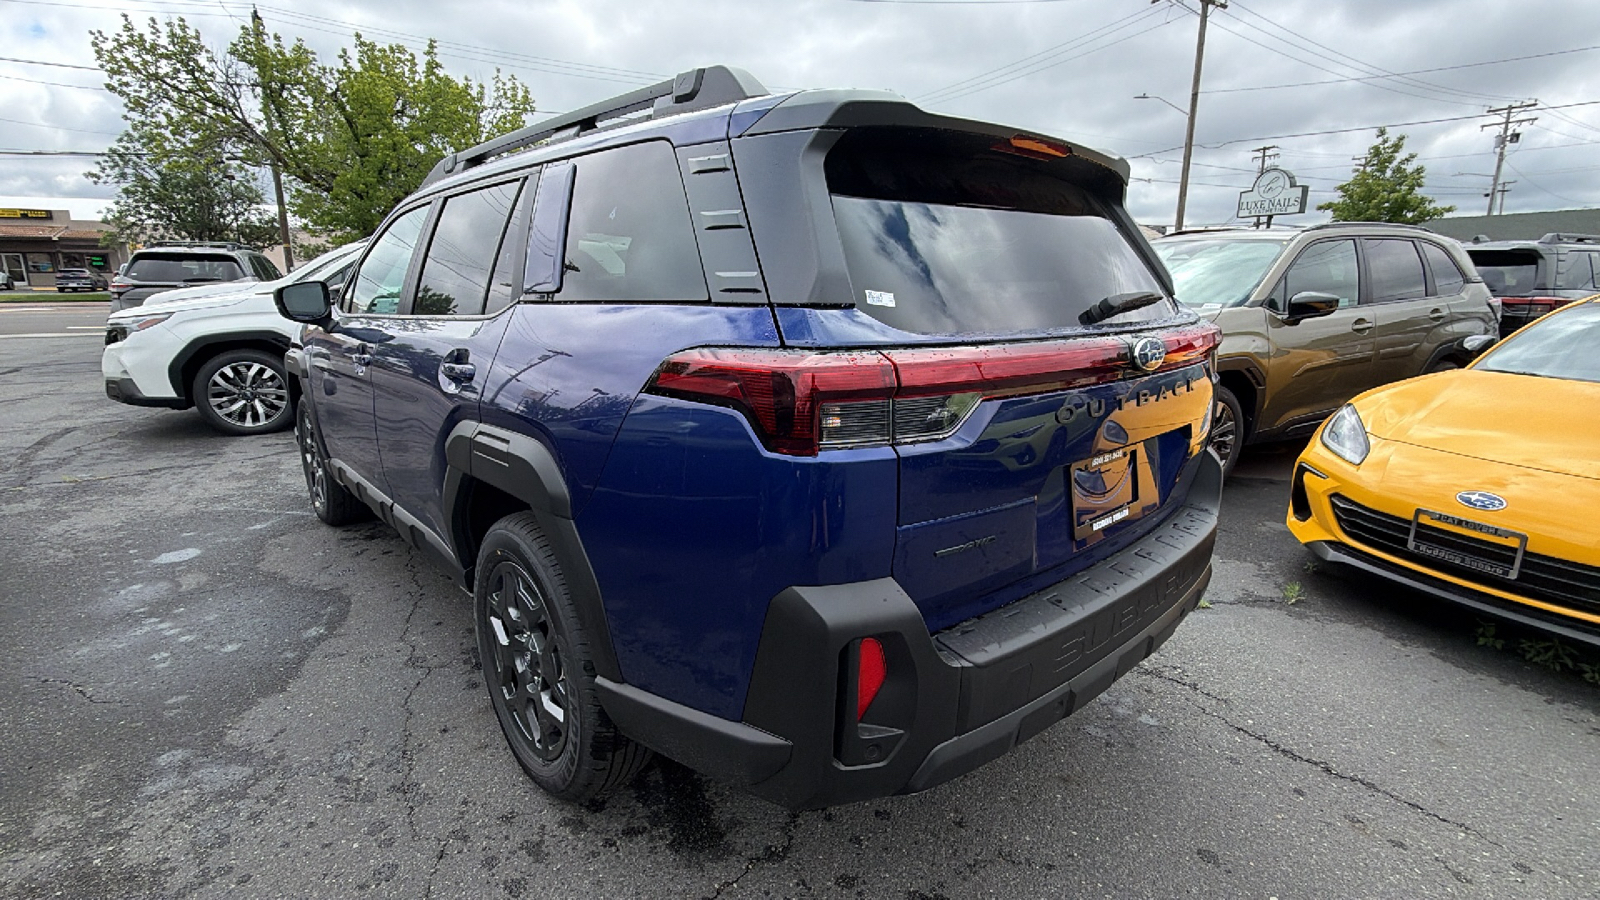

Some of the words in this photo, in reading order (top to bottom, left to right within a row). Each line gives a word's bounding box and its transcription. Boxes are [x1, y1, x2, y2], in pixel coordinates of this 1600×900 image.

[1239, 199, 1266, 211] LUXE
[1267, 197, 1300, 209] NAILS
[1054, 377, 1195, 425] OUTBACK
[1440, 514, 1460, 526] CAT
[1054, 569, 1194, 674] SUBARU
